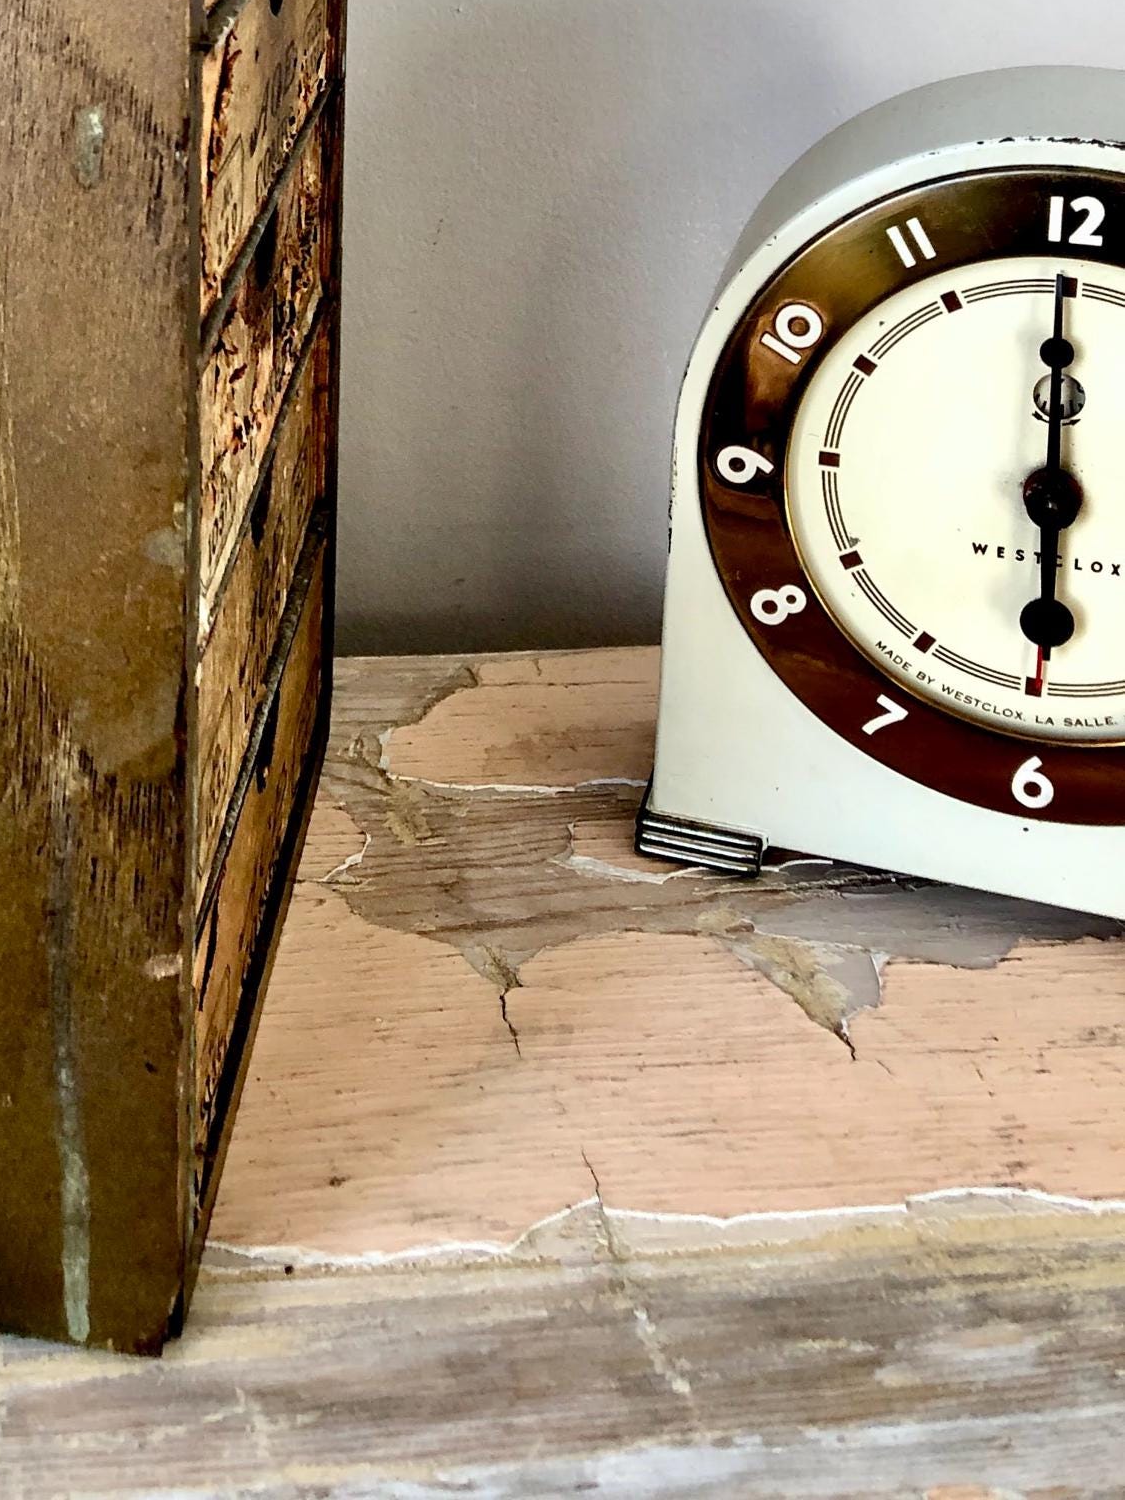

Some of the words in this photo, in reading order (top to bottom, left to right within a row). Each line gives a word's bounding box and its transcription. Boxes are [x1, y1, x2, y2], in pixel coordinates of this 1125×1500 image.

[886, 217, 937, 268] 11
[1047, 196, 1106, 247] 12
[761, 304, 823, 365] 10
[716, 445, 774, 484] 9
[750, 584, 807, 625] 8
[875, 640, 913, 673] MADE
[915, 670, 936, 686] BY
[1035, 715, 1055, 726] LA
[861, 694, 909, 735] 7
[1011, 755, 1054, 809] 6
